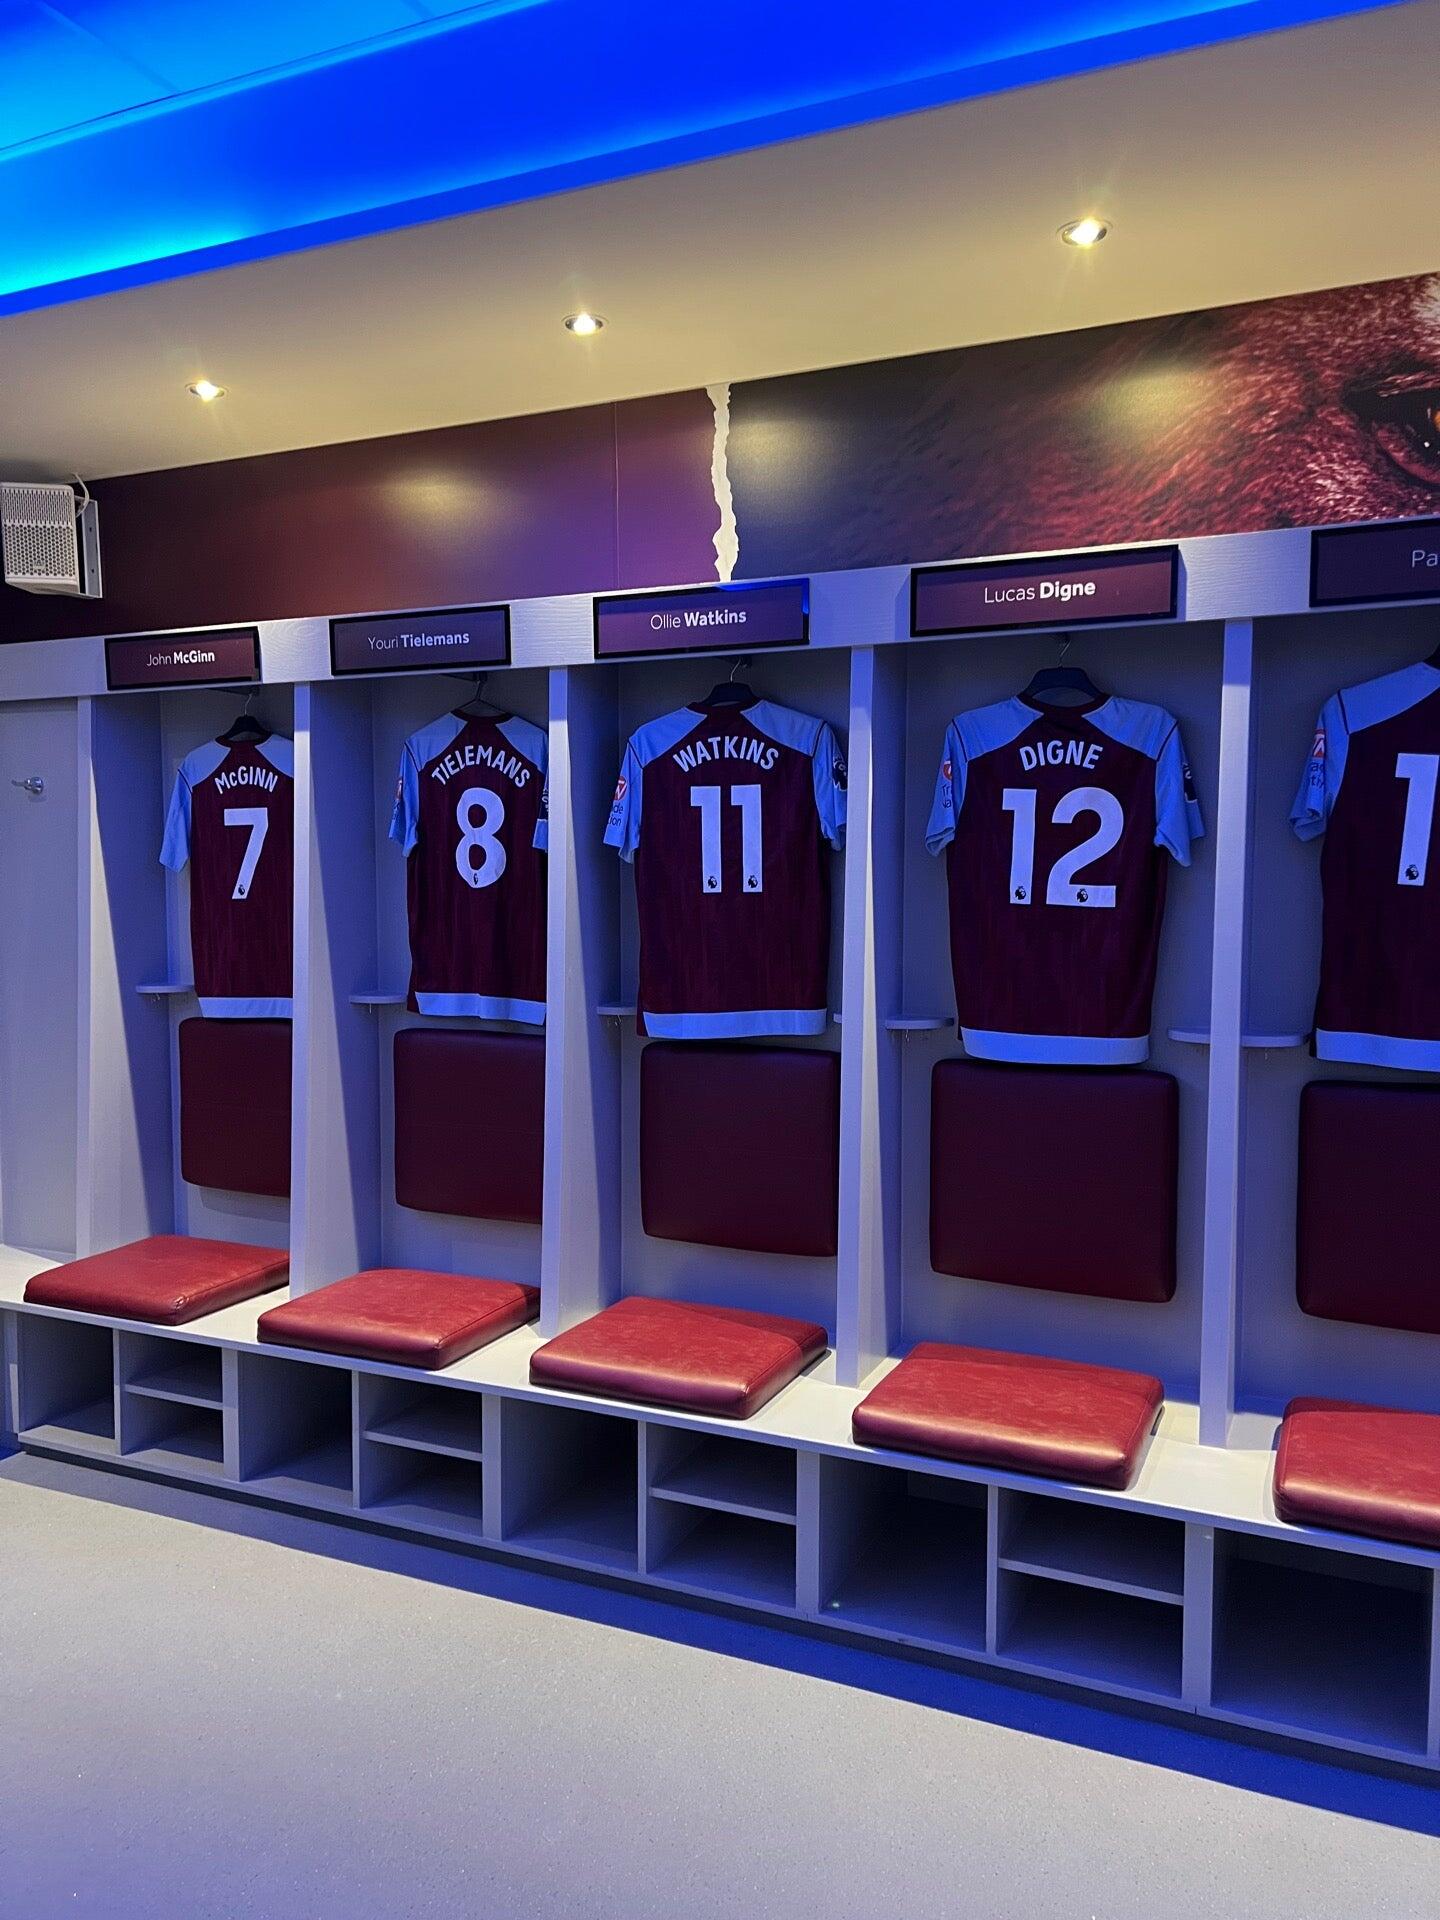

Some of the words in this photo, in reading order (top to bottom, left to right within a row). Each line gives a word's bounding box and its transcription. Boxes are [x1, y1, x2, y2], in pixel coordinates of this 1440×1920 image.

[984, 587, 1036, 604] Lucas
[1039, 580, 1096, 602] Digne
[650, 613, 681, 630] Ollie
[684, 610, 747, 627] Watkins
[368, 636, 399, 650] Youri
[401, 632, 470, 648] Tielemans
[146, 653, 172, 667] John
[173, 650, 215, 664] McGinn
[431, 744, 531, 789] TIELEMANS
[673, 735, 779, 773] WATKINS
[1019, 740, 1104, 771] DIGNE
[214, 765, 279, 795] McGINN
[223, 807, 269, 900] 7
[455, 787, 507, 889] 8
[690, 783, 763, 894] 11
[1002, 786, 1124, 908] 12
